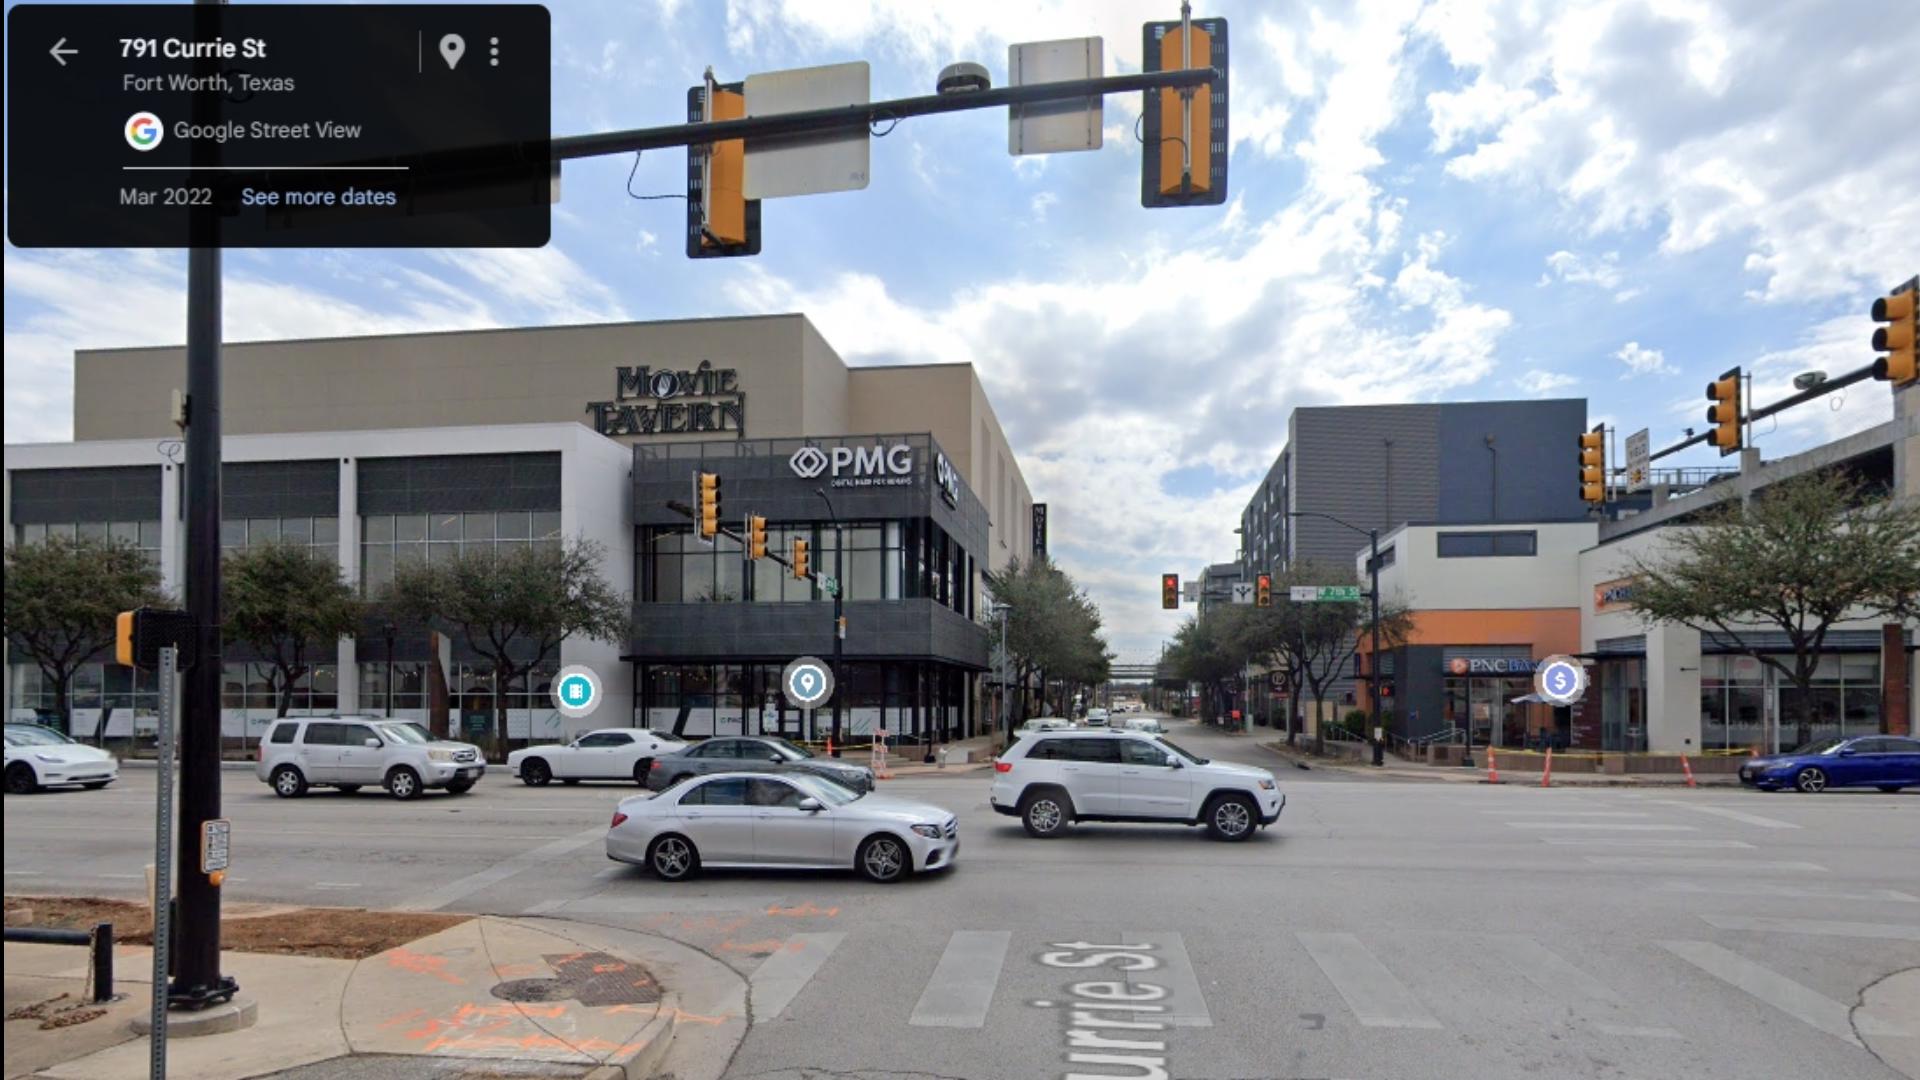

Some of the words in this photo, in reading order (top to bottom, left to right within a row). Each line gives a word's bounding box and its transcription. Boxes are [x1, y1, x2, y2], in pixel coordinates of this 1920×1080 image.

[616, 360, 738, 402] MOVIE
[586, 392, 746, 439] TAVERN
[832, 444, 912, 477] PMG
[1470, 658, 1507, 673] PNC
[1509, 658, 1545, 673] BAN
